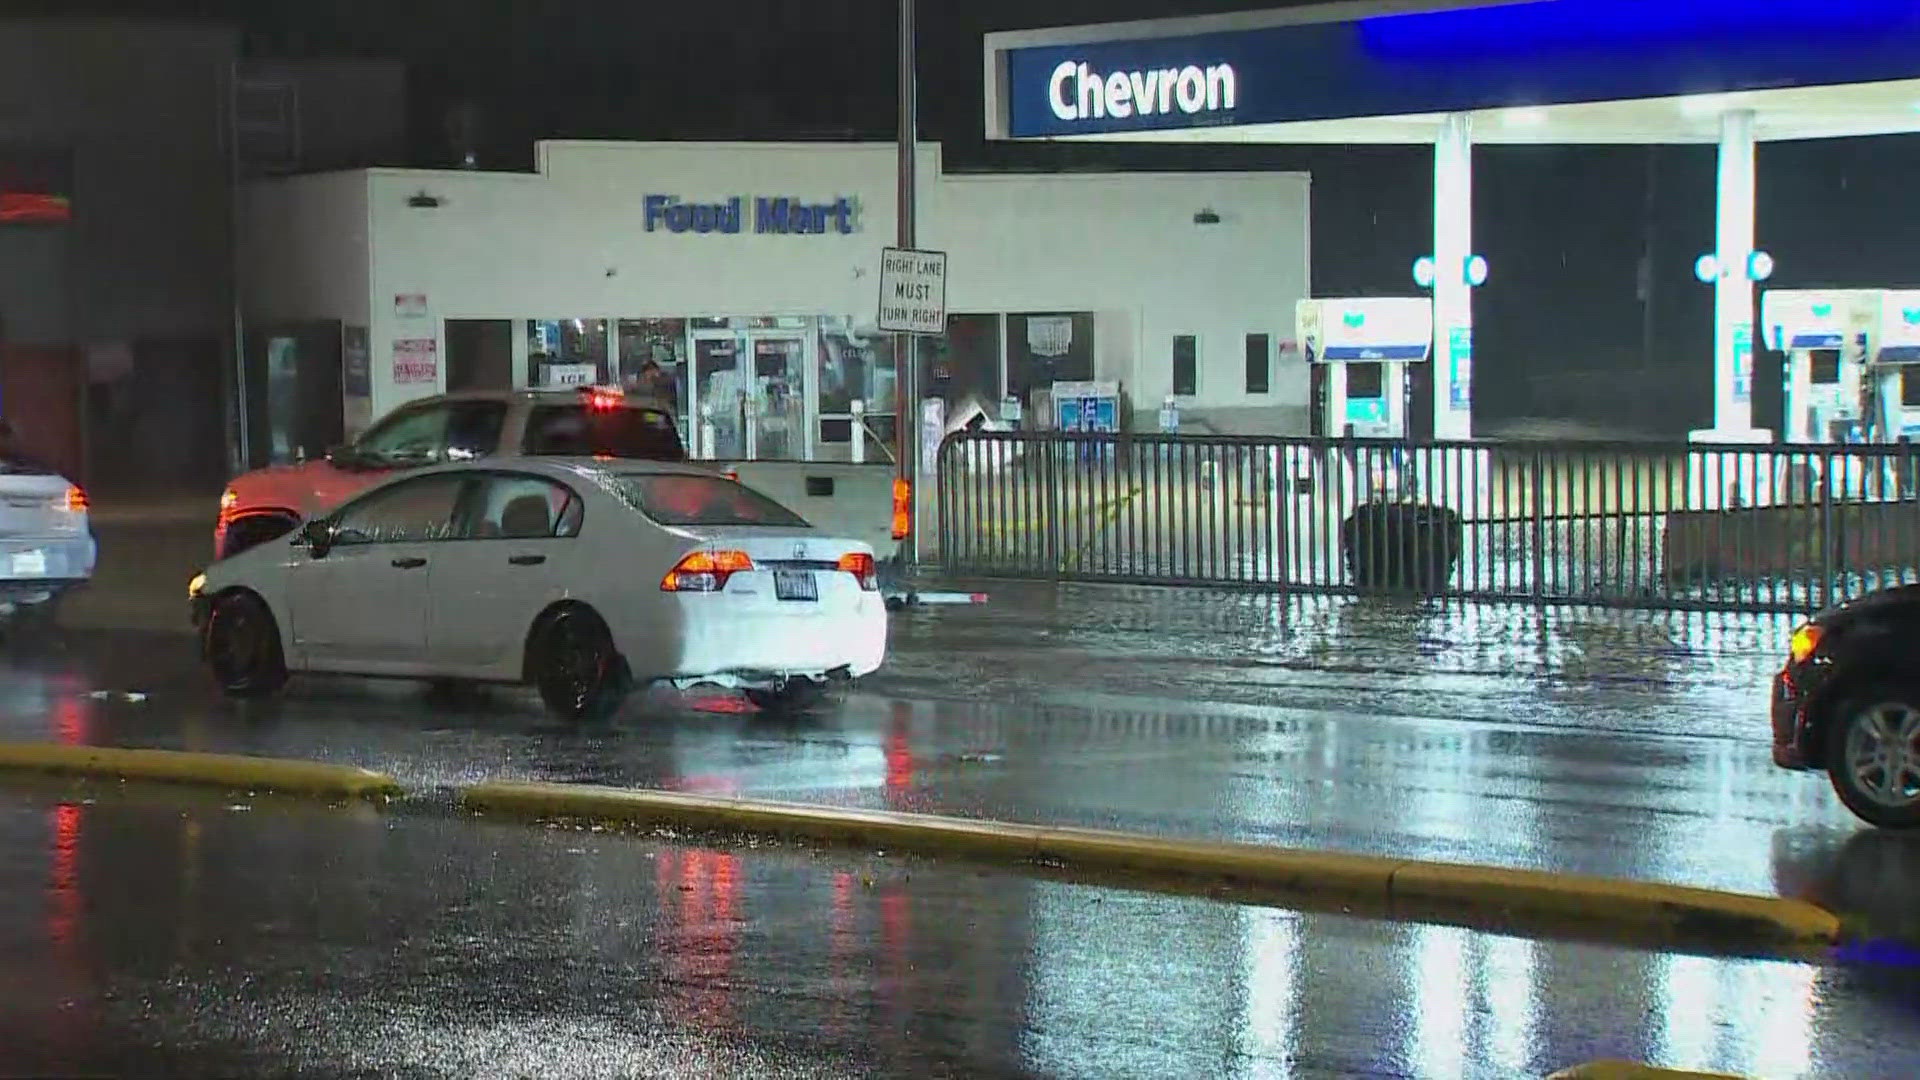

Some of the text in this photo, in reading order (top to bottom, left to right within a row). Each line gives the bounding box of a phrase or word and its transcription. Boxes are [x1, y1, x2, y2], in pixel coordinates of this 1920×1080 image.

[1049, 60, 1236, 121] Chevron
[643, 194, 853, 234] Food Mart
[885, 258, 942, 276] RIGHT LANE
[895, 282, 930, 301] MUST
[882, 306, 941, 325] TURN RIGHT
